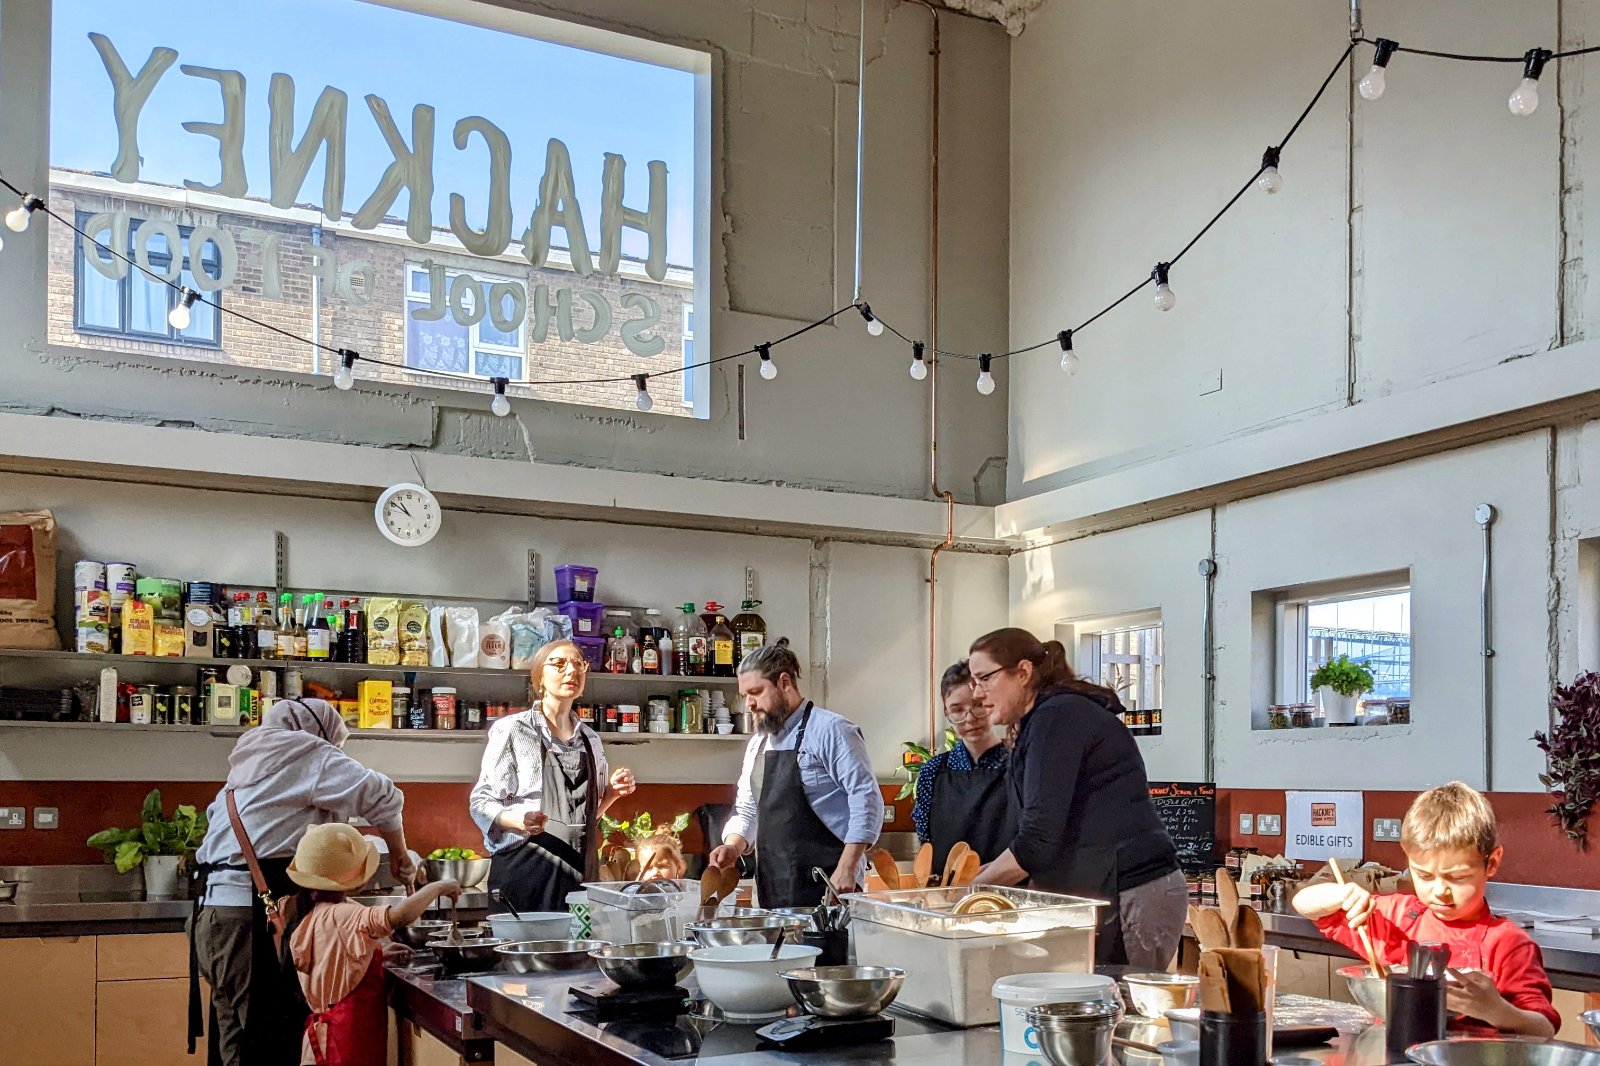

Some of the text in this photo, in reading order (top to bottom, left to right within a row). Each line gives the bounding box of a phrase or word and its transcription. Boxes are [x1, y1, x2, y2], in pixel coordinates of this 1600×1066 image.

[622, 713, 640, 723] SPIC
[1180, 797, 1205, 806] GIFTS
[1296, 834, 1353, 848] EDIBLE GIFTS
